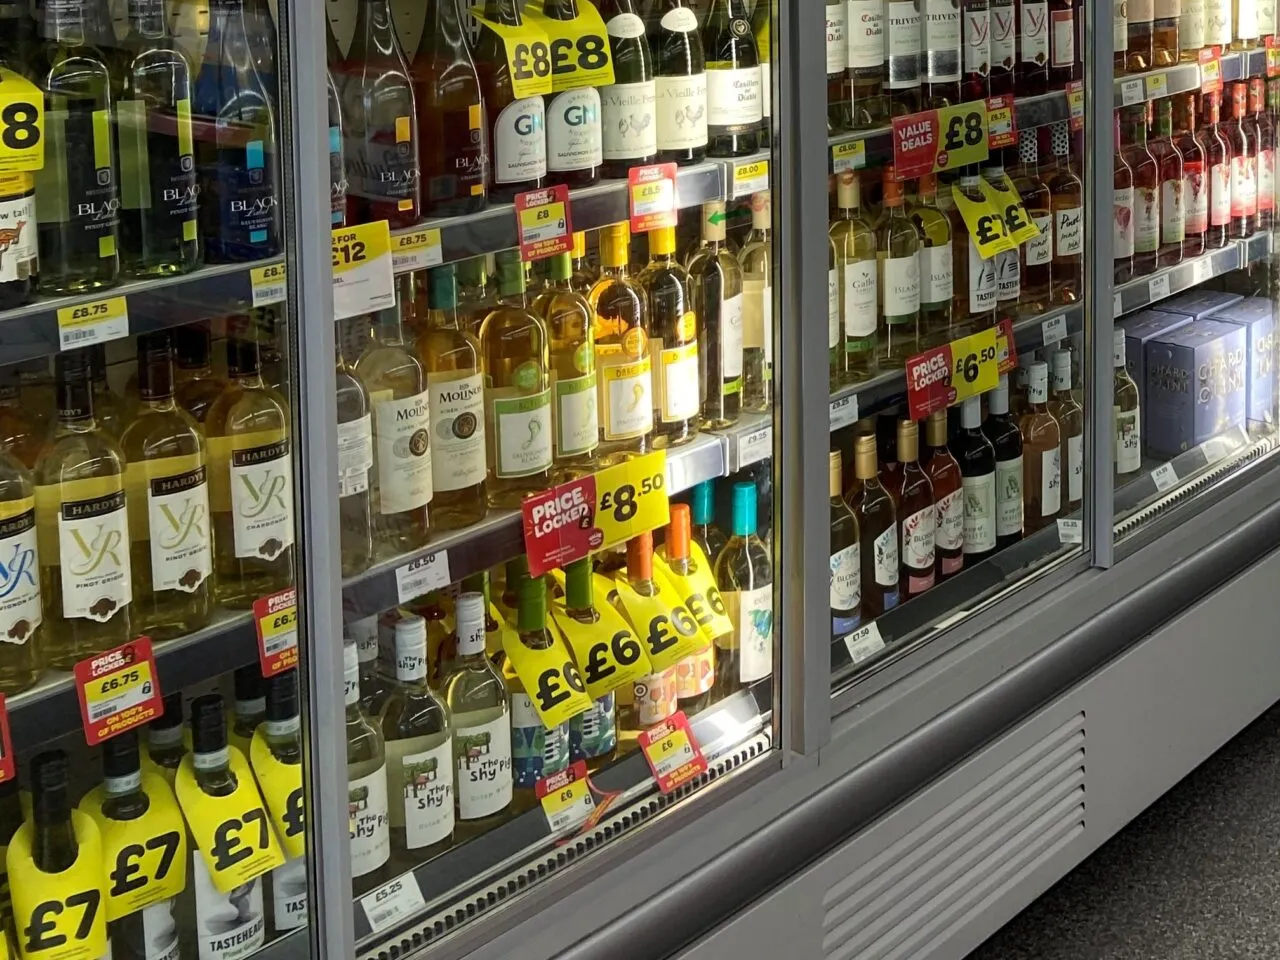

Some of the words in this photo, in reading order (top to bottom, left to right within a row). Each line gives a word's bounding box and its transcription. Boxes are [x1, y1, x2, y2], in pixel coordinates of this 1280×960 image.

[513, 43, 550, 81] £8
[551, 34, 608, 74] £8
[564, 103, 597, 127] GN
[898, 121, 931, 140] VALUE
[944, 111, 983, 151] £8
[838, 143, 857, 153] £8.00
[901, 134, 933, 152] DEALS
[736, 165, 759, 176] £8.00
[537, 210, 549, 220] £8
[337, 234, 357, 245] FOR
[400, 234, 427, 246] £8.75
[72, 303, 108, 319] £8.75
[912, 352, 946, 380] PRICE
[955, 345, 996, 383] £6.50
[914, 367, 949, 391] LOCKED
[532, 486, 583, 524] PRICE
[600, 473, 664, 522] £8.50
[534, 504, 589, 538] LOCKED
[407, 553, 436, 572] £6.50
[76, 581, 99, 589] PINOT
[686, 586, 726, 627] £6
[647, 605, 698, 656] £6
[91, 650, 123, 668] PRICE
[585, 630, 641, 685] £6
[92, 659, 125, 677] LOCKED
[101, 671, 139, 693] £6.75
[536, 661, 586, 712] £6
[98, 727, 111, 737] OF
[111, 708, 154, 733] PRODUCTS
[107, 715, 120, 724] ON
[661, 740, 673, 752] £6
[470, 767, 497, 782] shy
[481, 758, 498, 769] The
[499, 757, 511, 772] pig
[429, 785, 445, 796] The
[560, 789, 573, 802] £6
[418, 794, 443, 810] shy
[359, 815, 377, 826] The
[210, 807, 270, 871] £7
[110, 830, 181, 898] £7
[375, 881, 402, 902] £5.25
[24, 889, 102, 953] £7
